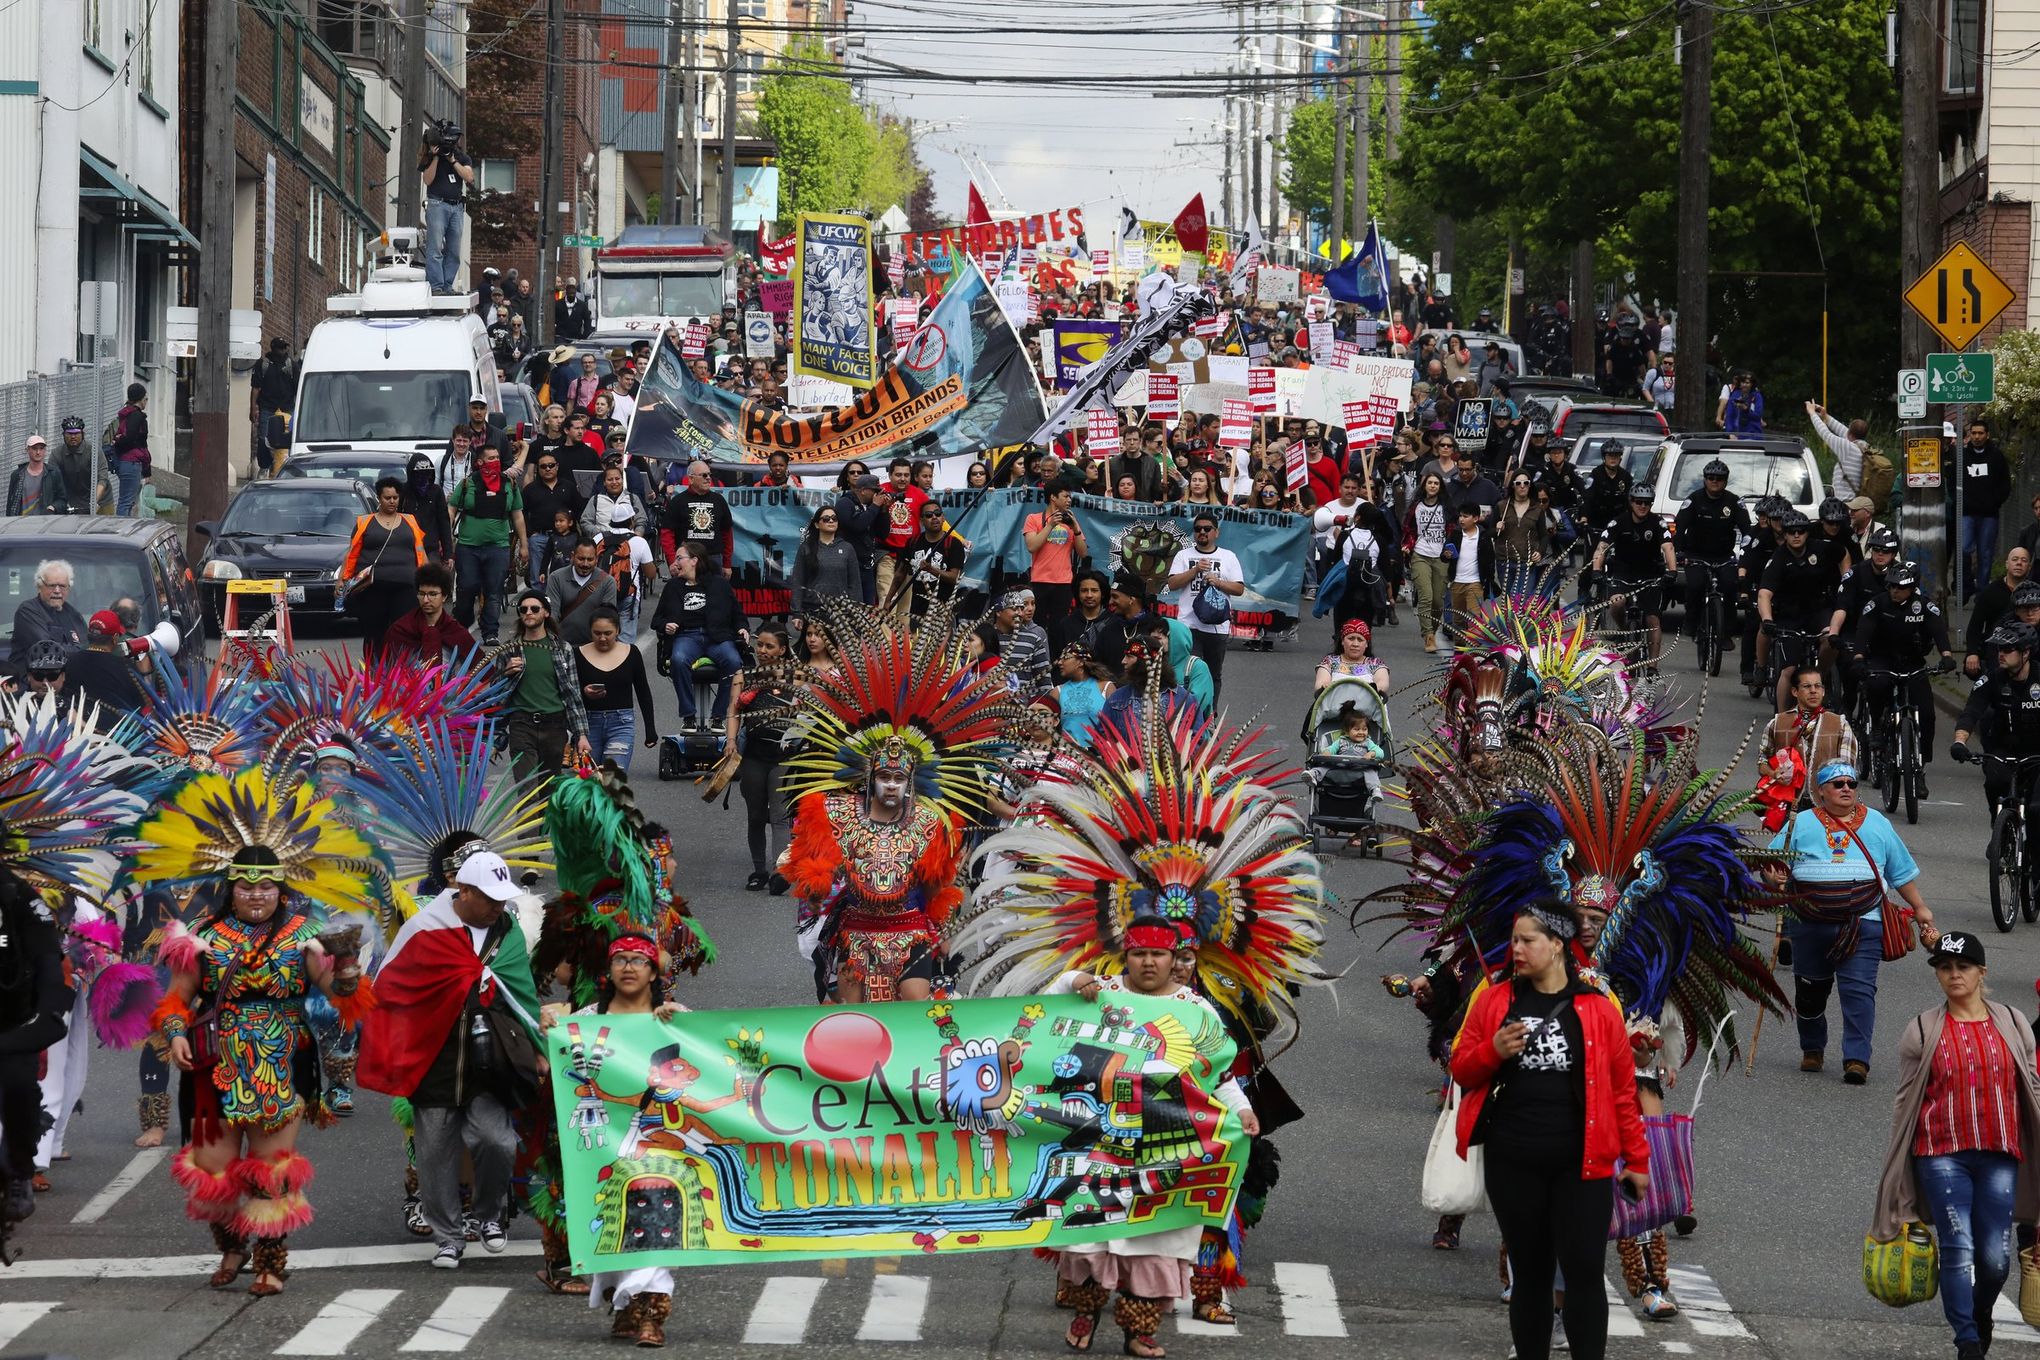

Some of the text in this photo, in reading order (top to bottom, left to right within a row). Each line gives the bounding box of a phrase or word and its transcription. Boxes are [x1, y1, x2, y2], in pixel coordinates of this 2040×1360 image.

[818, 225, 858, 239] UFCW
[803, 342, 870, 362] MANY FACES
[804, 354, 870, 377] ONE VOICE
[1063, 366, 1081, 381] SEI
[1371, 376, 1391, 388] NOT
[1908, 378, 1917, 390] P
[891, 377, 960, 424] BRANDS
[1379, 399, 1396, 407] WALL
[1464, 401, 1484, 412] NO
[1088, 411, 1097, 419] NO
[1377, 406, 1397, 416] RAIDS
[1089, 421, 1097, 429] NO
[1098, 420, 1118, 428] RAIDS
[1376, 415, 1391, 425] WAR
[1462, 414, 1486, 426] U.S.
[1089, 429, 1114, 438] NO WAR
[1456, 427, 1489, 438] WAR!
[728, 490, 763, 507] OUT
[768, 490, 789, 507] OF
[1111, 500, 1167, 518] ESTADO
[1169, 502, 1188, 518] DE
[1190, 504, 1293, 529] WASHINGTON!
[1236, 610, 1273, 626] MAYO
[1904, 614, 1925, 623] POLICE
[491, 866, 508, 882] W
[746, 1128, 1012, 1211] TONALLI
